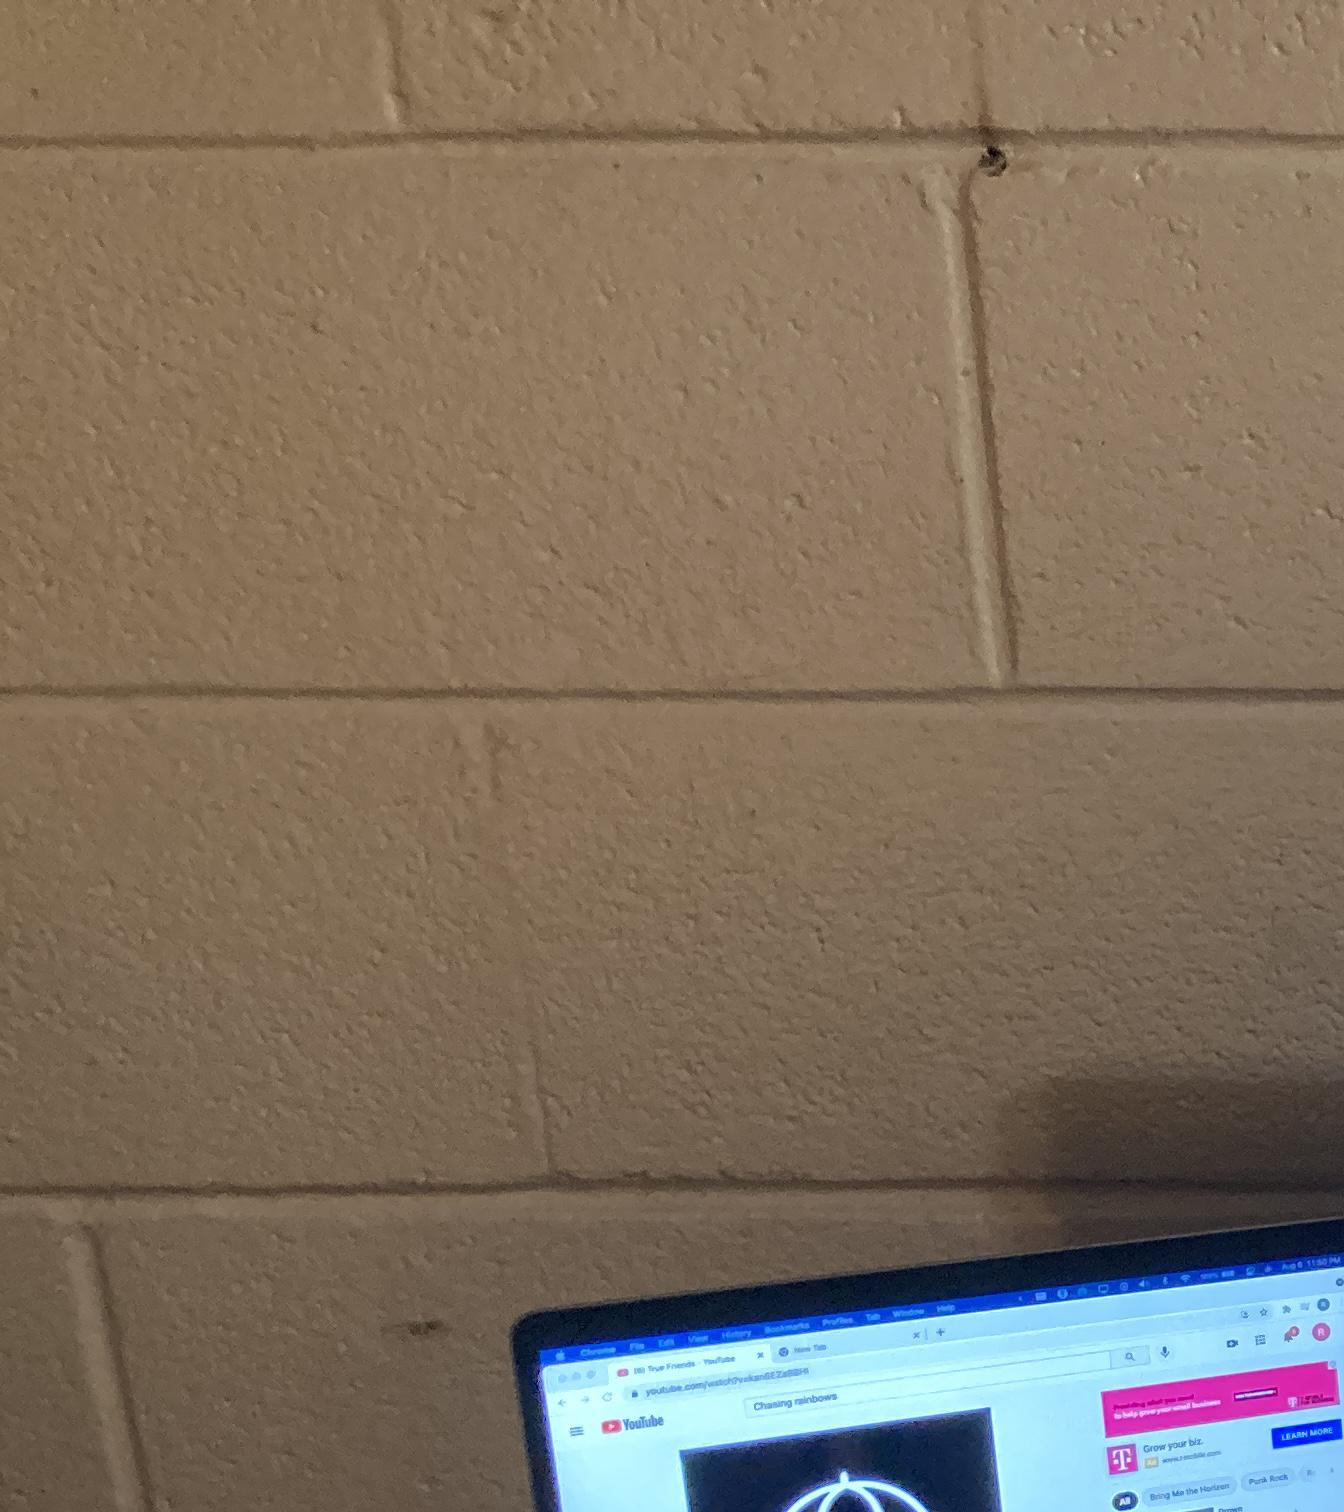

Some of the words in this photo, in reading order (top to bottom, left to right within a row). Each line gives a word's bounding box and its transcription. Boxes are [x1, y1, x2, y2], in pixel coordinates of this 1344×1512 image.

[722, 1328, 752, 1341] History
[893, 1306, 924, 1319] Window
[753, 1397, 793, 1414] Chasing
[794, 1391, 838, 1407] rainbows
[623, 1415, 664, 1431] YouTube
[1281, 1429, 1308, 1441] LEARN
[1309, 1426, 1333, 1438] MORE
[1143, 1442, 1167, 1454] Grow
[1168, 1440, 1187, 1453] your
[1248, 1474, 1268, 1486] Punk
[1269, 1472, 1289, 1483] Rock
[1150, 1489, 1170, 1502] Bring
[1171, 1487, 1185, 1497] Me
[1200, 1481, 1230, 1493] Horizon
